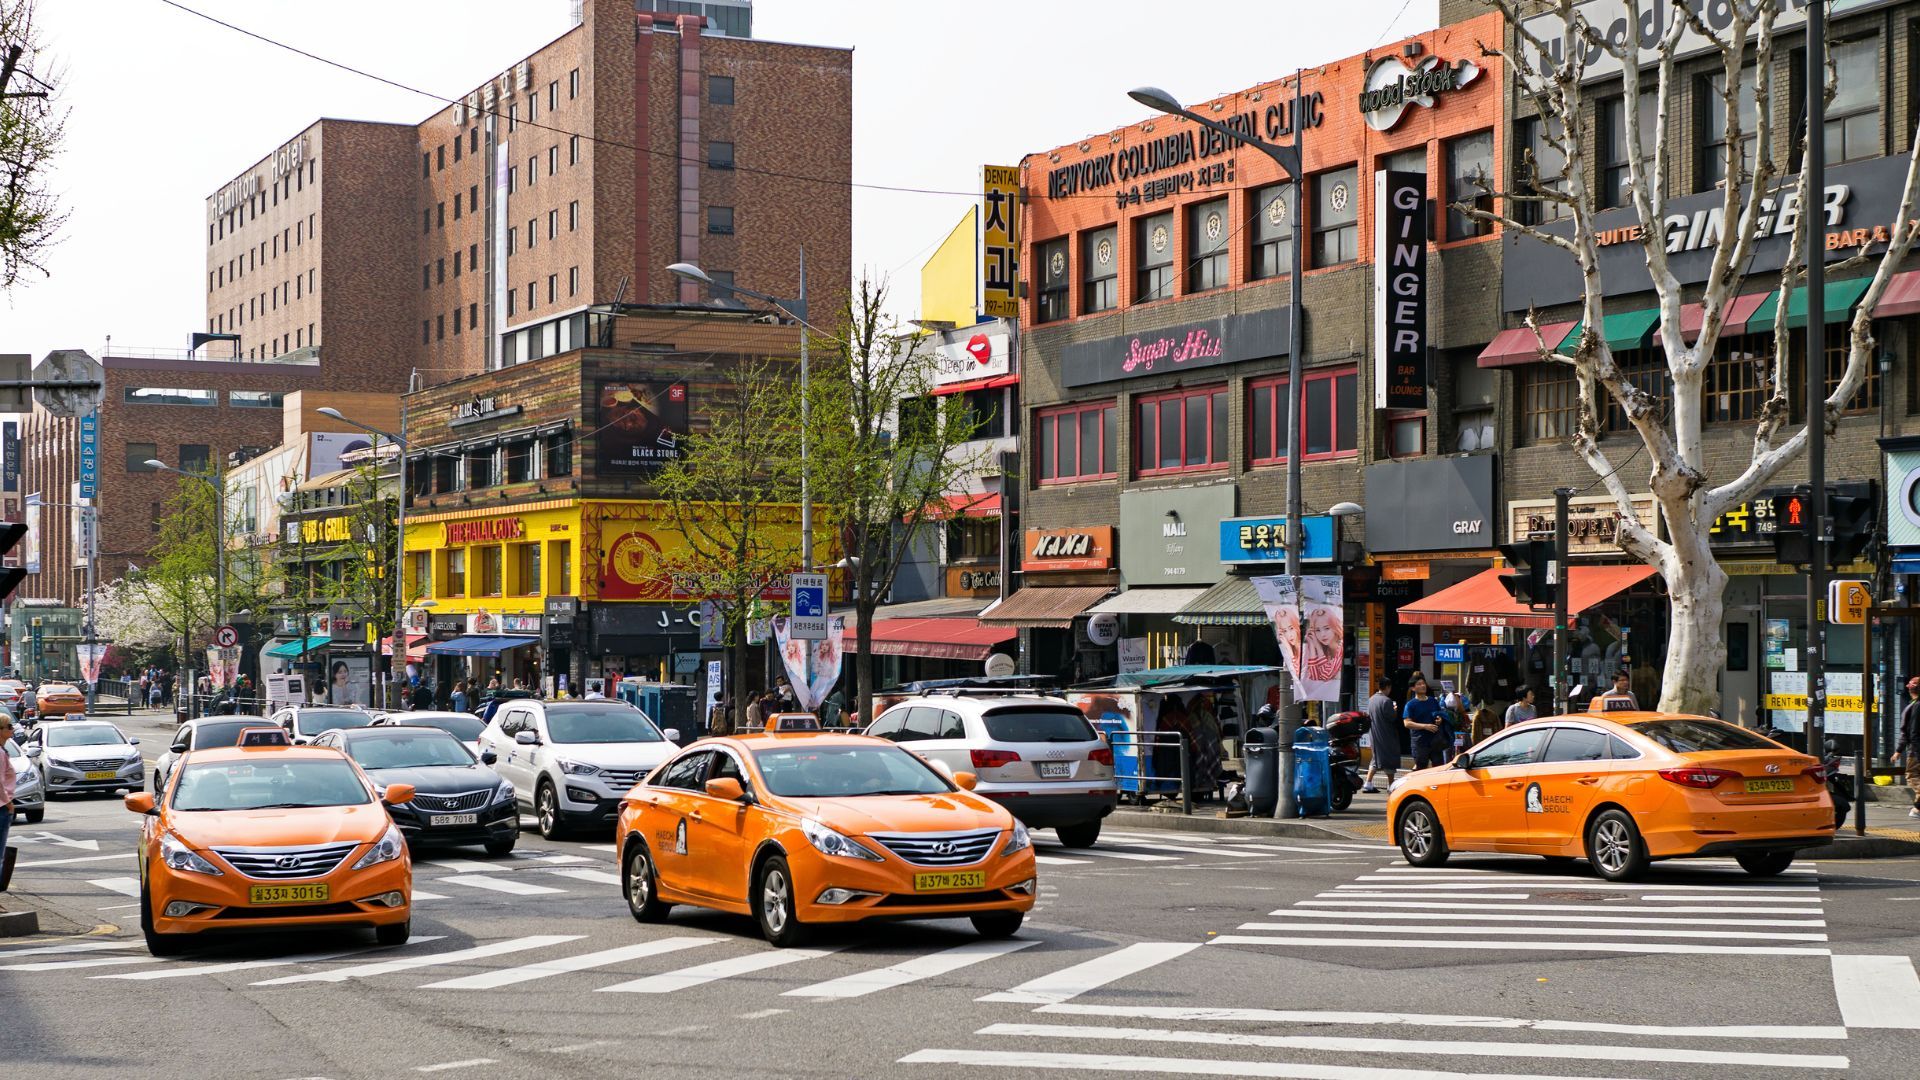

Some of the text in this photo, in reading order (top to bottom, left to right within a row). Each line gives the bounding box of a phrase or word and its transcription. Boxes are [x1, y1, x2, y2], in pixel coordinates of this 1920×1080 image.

[1360, 74, 1404, 113] wood
[1048, 152, 1115, 200] NEWYORK
[1116, 129, 1196, 181] COLUMBIA
[212, 135, 303, 219] Hamilton Hotel
[985, 169, 1018, 185] DENTAL
[1197, 163, 1226, 187] 치과
[986, 189, 1018, 298] 치과
[1393, 186, 1420, 353] GINGER
[985, 299, 1018, 315] 797-1771
[1123, 329, 1222, 372] Sugar Hill
[1398, 365, 1415, 375] BAR
[672, 389, 683, 398] 3F
[1390, 385, 1422, 396] LOUNGE
[83, 411, 96, 496] 밀톤쇼핑센타
[632, 449, 678, 458] BLACK STONE
[446, 523, 466, 543] THE
[467, 519, 494, 542] HALAL
[1163, 523, 1187, 537] NAIL
[1453, 520, 1481, 534] GRAY
[1239, 525, 1306, 549] 큰옷전
[796, 578, 823, 587] 이태원로
[1378, 587, 1393, 596] FOR
[1444, 649, 1460, 658] ATM
[709, 674, 720, 684] A/S
[1609, 700, 1632, 709] TAXI
[786, 720, 811, 729] 서울
[1543, 805, 1570, 814] SEOUL
[453, 815, 473, 823] 7018
[953, 872, 982, 887] 2531
[291, 886, 324, 899] 3015
